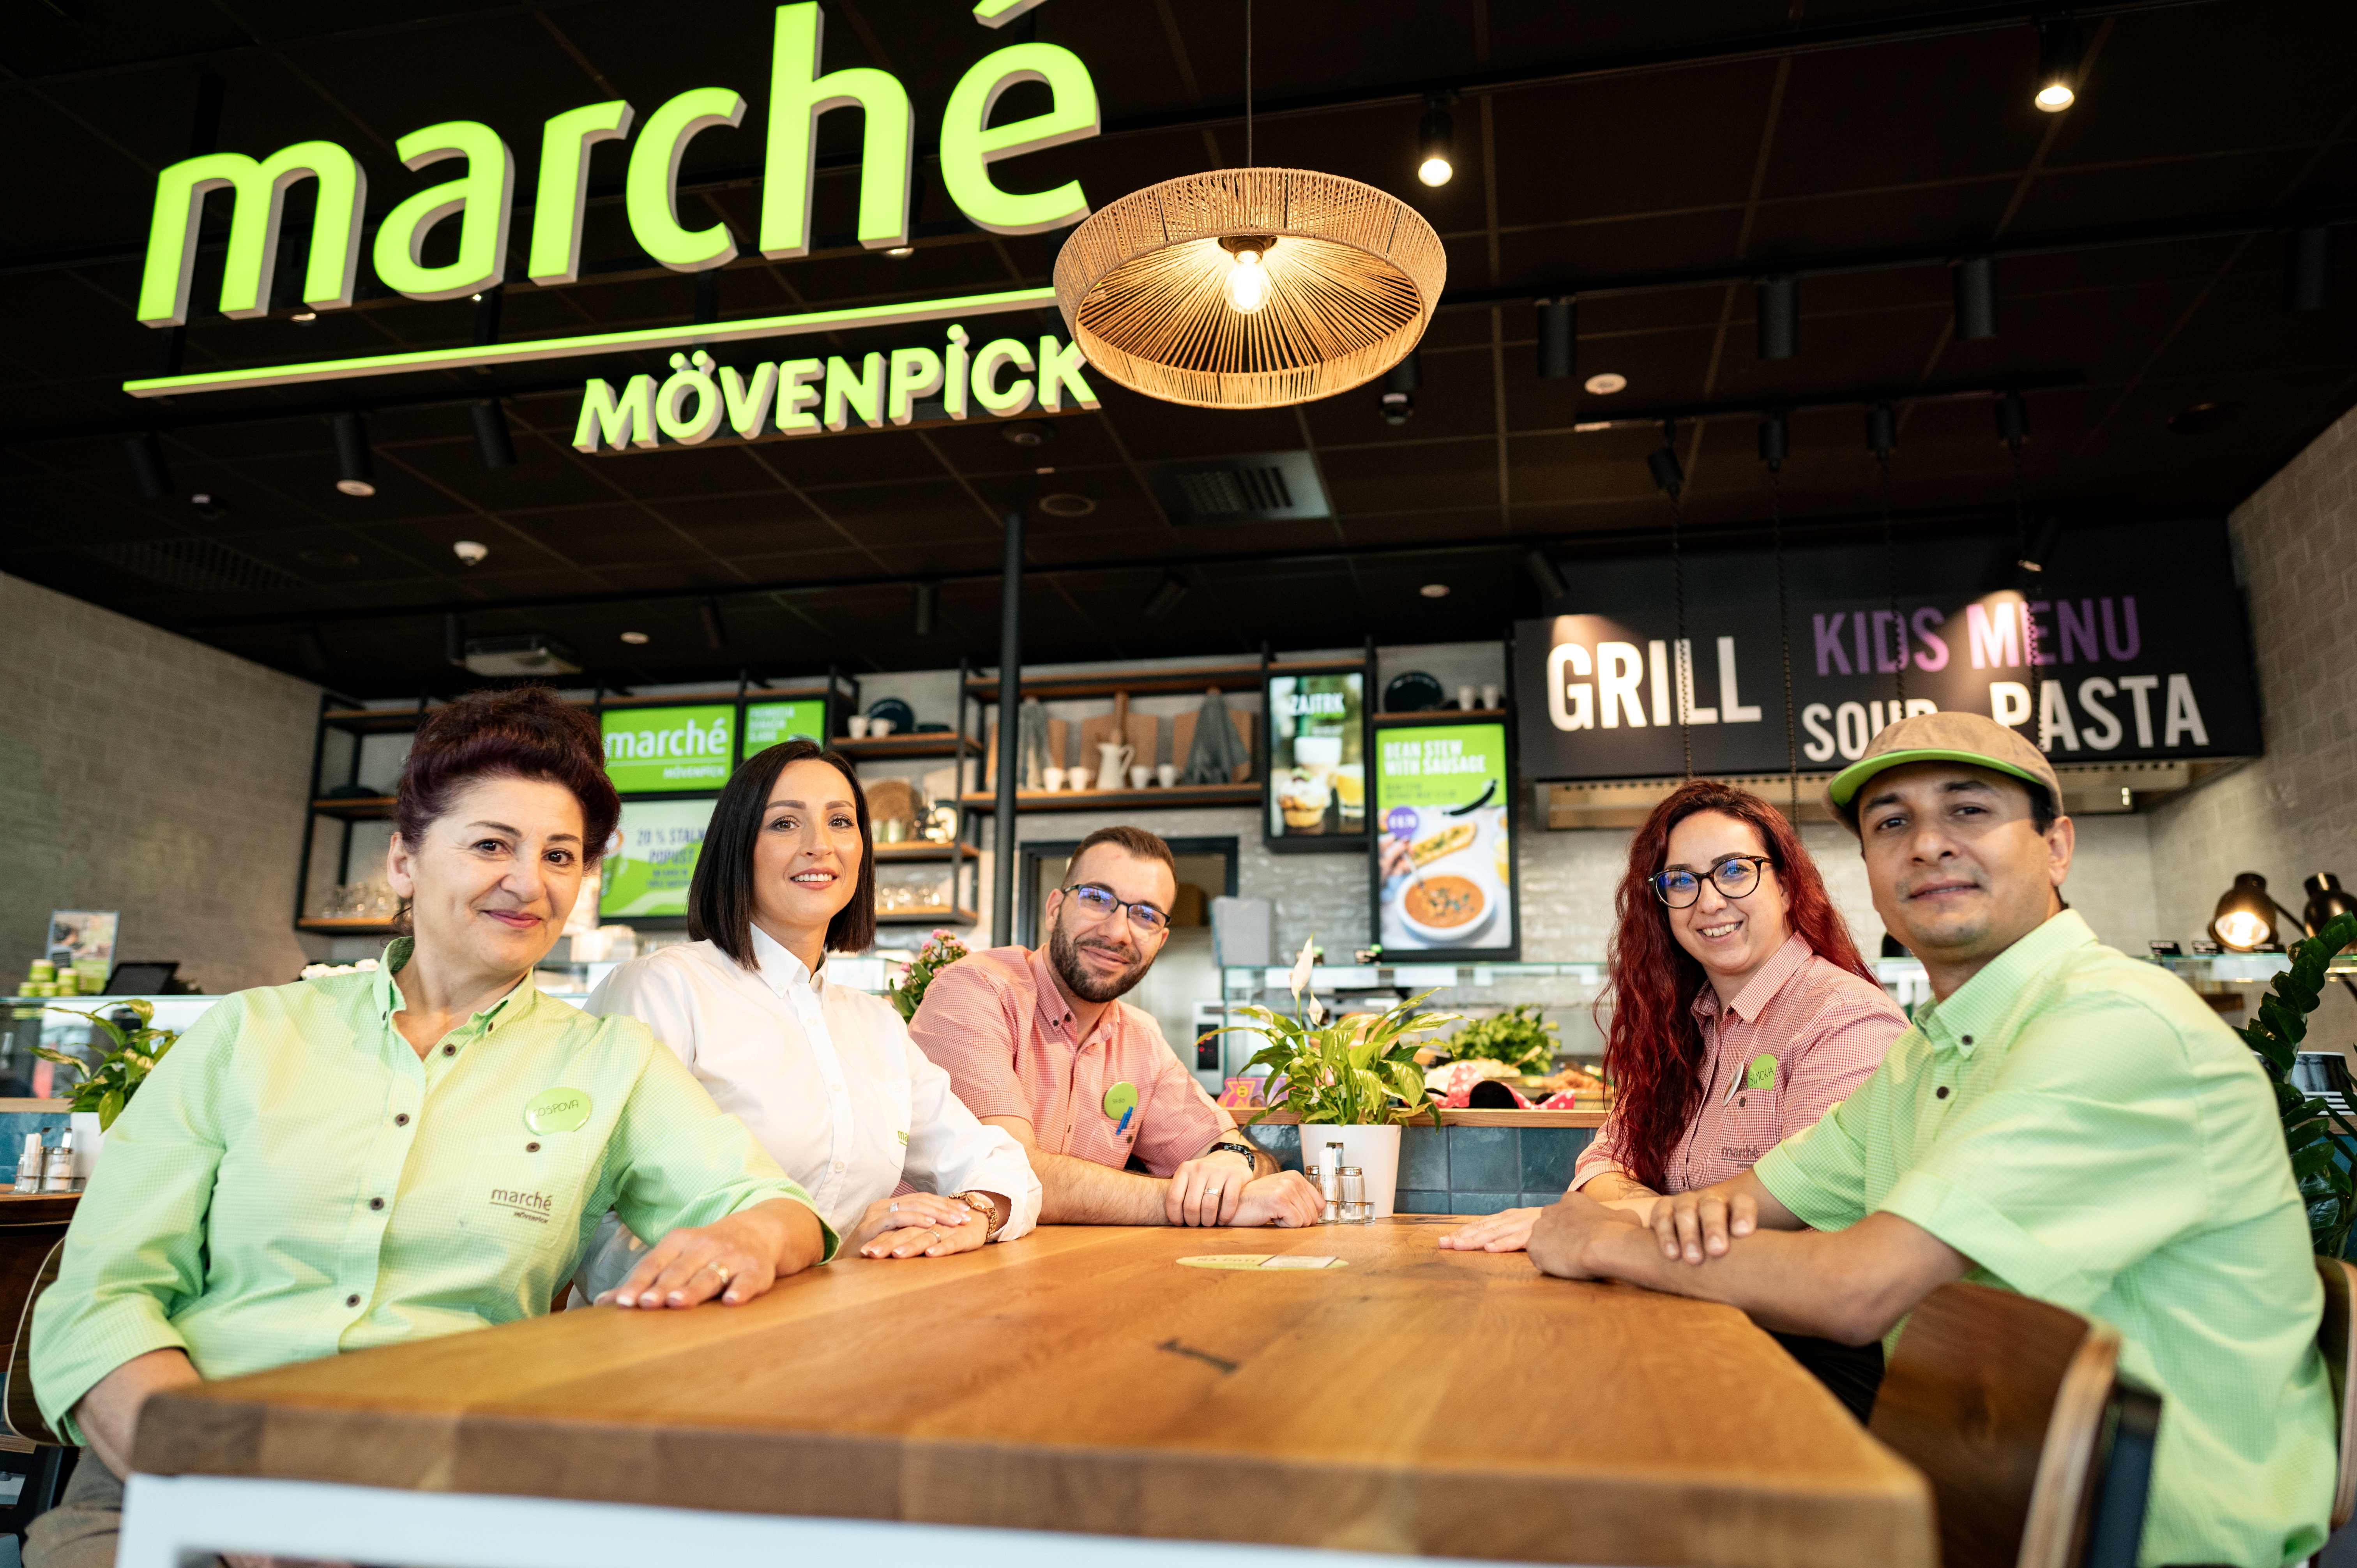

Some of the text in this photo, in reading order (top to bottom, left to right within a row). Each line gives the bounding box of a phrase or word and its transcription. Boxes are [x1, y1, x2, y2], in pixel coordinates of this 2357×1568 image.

[136, 0, 1101, 328] marché
[1812, 595, 2142, 677] KIDS MENU
[1546, 636, 1762, 733] GRILL
[1989, 673, 2210, 753] PASTA
[605, 717, 727, 758] marché
[1801, 697, 1939, 763] SO
[1749, 1067, 1774, 1086] SIMONA
[491, 1188, 553, 1211] marché
